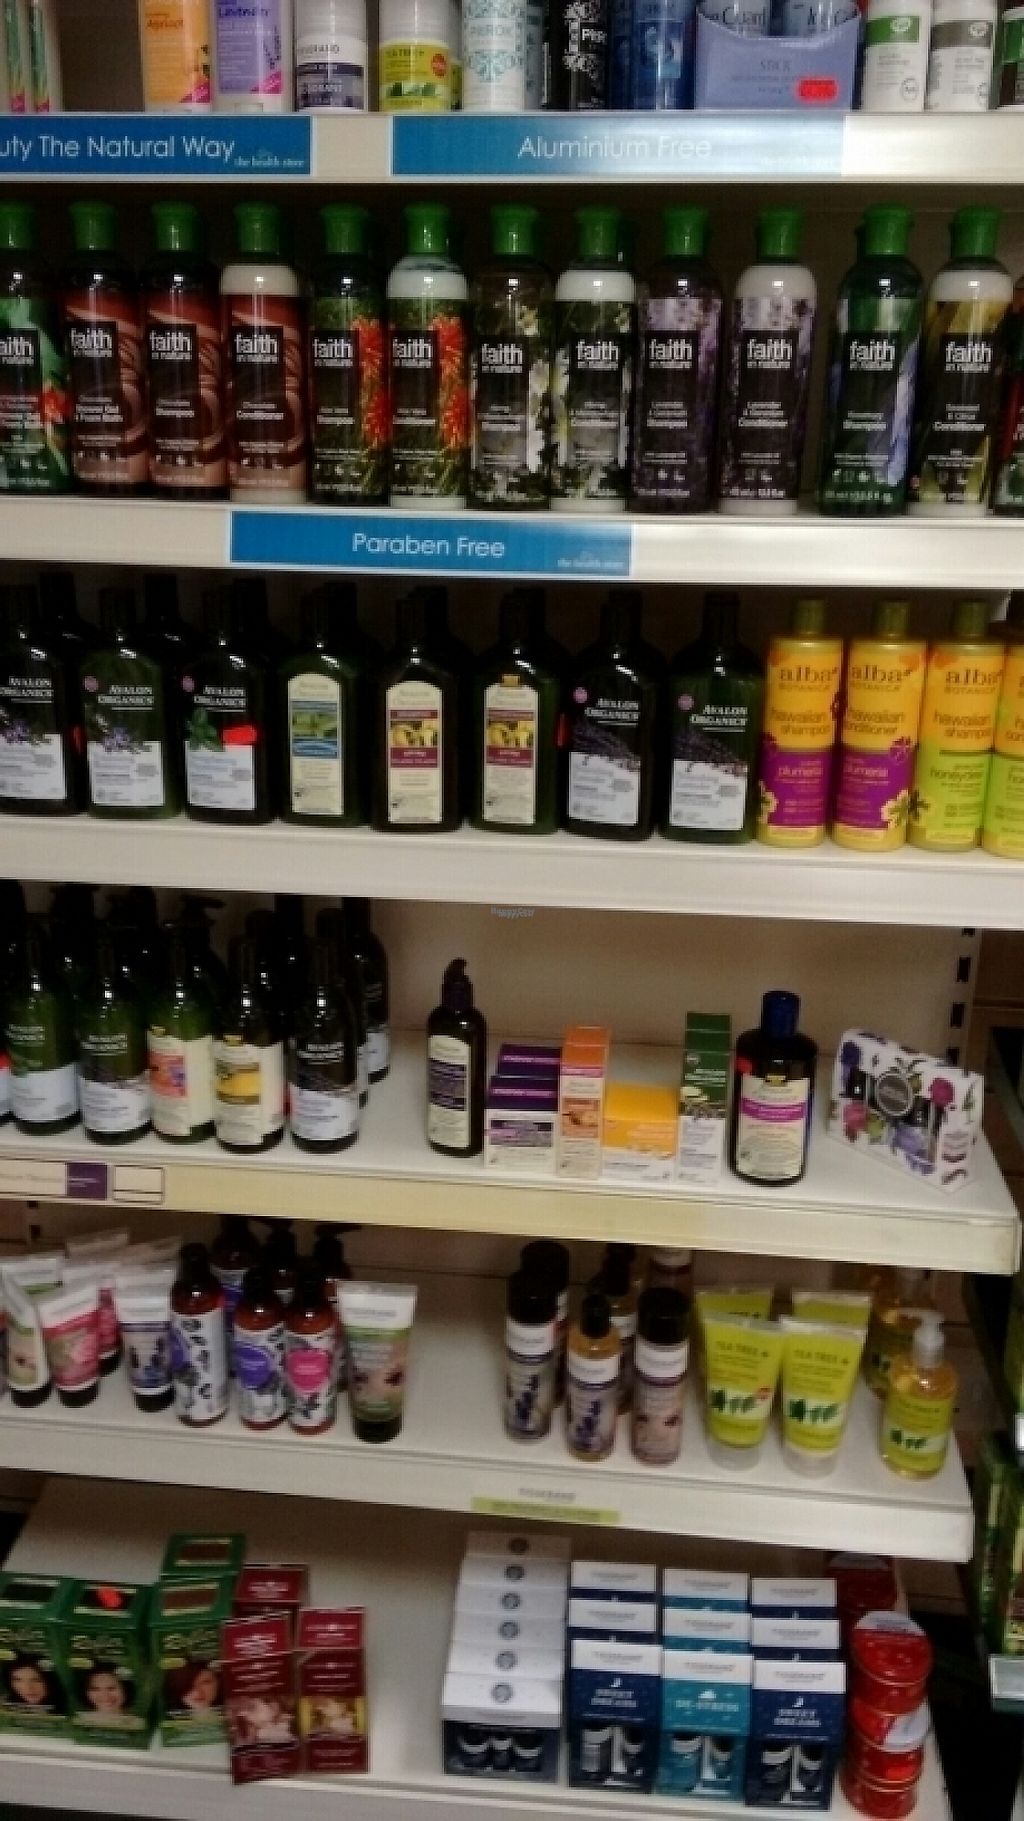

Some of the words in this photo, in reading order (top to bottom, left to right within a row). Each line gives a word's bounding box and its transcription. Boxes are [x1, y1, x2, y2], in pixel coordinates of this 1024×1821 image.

[38, 134, 80, 157] The
[87, 134, 175, 158] Natural
[182, 135, 235, 163] Way
[517, 135, 650, 159] Aluminium
[657, 136, 712, 159] Free
[252, 155, 279, 168] health
[283, 157, 305, 168] store
[70, 328, 112, 350] faith
[149, 330, 191, 352] faith
[234, 334, 278, 355] faith
[312, 338, 354, 358] faith
[392, 338, 433, 358] faith
[481, 343, 523, 365] faith
[575, 338, 619, 360] faith
[648, 338, 693, 360] faith
[746, 339, 792, 361] faith
[849, 340, 895, 362] faith
[945, 341, 992, 364] faith
[738, 417, 788, 428] Conditioner
[933, 421, 986, 432] Conditioner
[351, 533, 449, 557] Paraben
[455, 536, 506, 558] Free
[9, 676, 52, 687] AVALON
[779, 667, 832, 682] alba
[851, 665, 903, 683] alba
[945, 669, 1000, 685] alba
[109, 684, 153, 695] AVALON
[202, 685, 245, 697] AVALON
[97, 694, 155, 704] ORGANICS
[193, 695, 247, 707] ORGANICS
[597, 698, 639, 711] AVALON
[584, 707, 640, 721] ORGANICS
[703, 704, 748, 716] AVALON
[689, 715, 748, 728] ORGANICS
[735, 1343, 758, 1357] TREE
[794, 1349, 813, 1361] TEA
[815, 1351, 838, 1364] TREE
